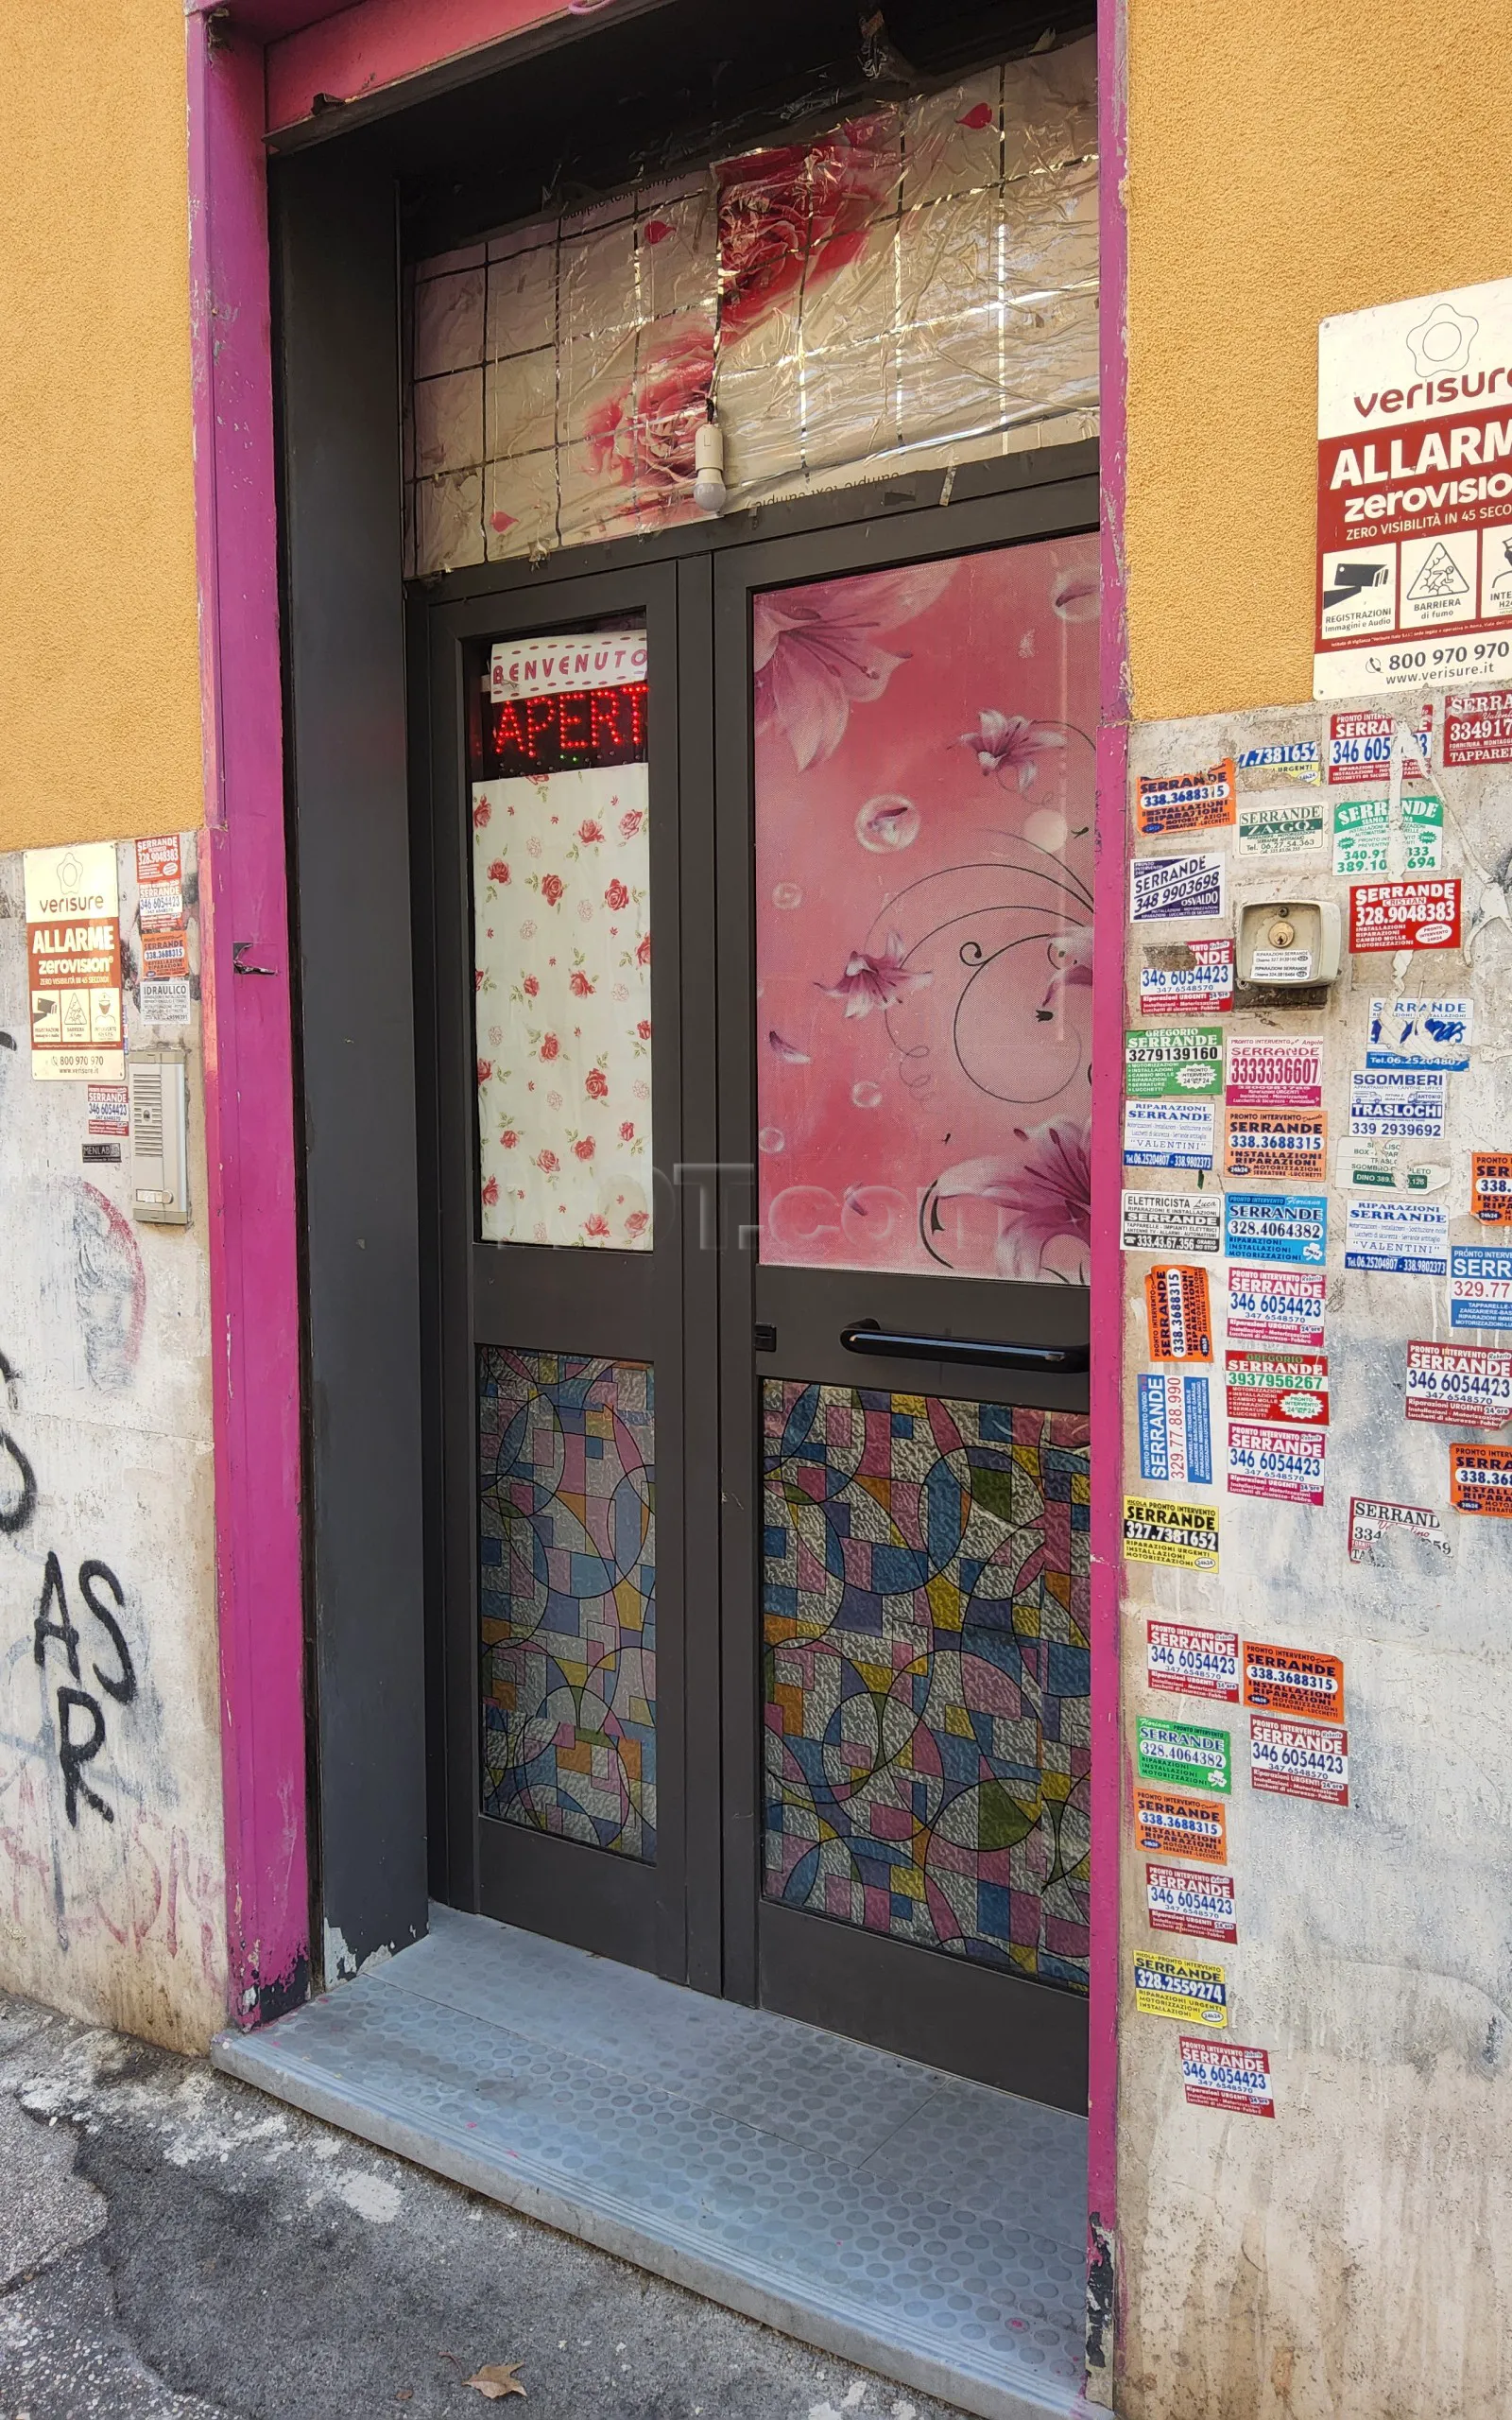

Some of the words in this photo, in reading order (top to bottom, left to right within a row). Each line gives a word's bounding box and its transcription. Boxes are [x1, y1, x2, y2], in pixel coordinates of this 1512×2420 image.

[1353, 367, 1512, 419] verisur
[1346, 526, 1377, 541] ZERO
[1381, 513, 1441, 535] VISIBILITÀ
[1445, 513, 1457, 525] IN
[1462, 507, 1475, 521] 45
[1326, 608, 1391, 624] REGISTRAZIONI
[1414, 598, 1461, 612] BARRIERA
[1420, 611, 1431, 620] di
[1434, 609, 1453, 617] fumo
[1325, 620, 1360, 632] Immagini
[1368, 617, 1391, 628] Audio
[492, 648, 647, 685] BENVENUTO
[1388, 651, 1426, 671] 800
[1433, 646, 1468, 666] 970
[1474, 641, 1510, 661] 970
[1386, 662, 1494, 684] www.verisure.it
[1333, 739, 1359, 764] 346
[1241, 806, 1320, 824] SERRANDE
[1338, 800, 1439, 825] SERRNDE
[137, 837, 178, 851] SERRANDE
[1136, 856, 1206, 893] SERRANDE
[140, 886, 180, 898] SERRANDE
[1134, 892, 1159, 913] 348
[1162, 872, 1219, 904] 9903698
[1181, 891, 1218, 906] OSVALDO
[1356, 883, 1454, 906] SERRANDE
[40, 895, 104, 913] verisure
[1356, 900, 1454, 926] 328.9048383
[32, 925, 114, 954] ALLARME
[1143, 969, 1166, 987] 346
[1171, 965, 1228, 985] 6054423
[144, 985, 186, 994] IDRAULICO
[1127, 1035, 1217, 1047] SERRANDE
[1145, 1028, 1198, 1037] GREGORIO
[60, 1056, 74, 1065] 800
[76, 1056, 88, 1065] 970
[1129, 1046, 1217, 1062] 3279139160
[1230, 1047, 1319, 1056] SERRANDE
[1231, 1058, 1318, 1083] 3333336607
[1353, 1074, 1442, 1085] SGOMBERI
[89, 1092, 127, 1103] SERRANDE
[1136, 1103, 1206, 1112] RIPARAZIONI
[1128, 1110, 1211, 1121] SERRANDE
[1353, 1105, 1442, 1117] TRASLOCHI
[1230, 1122, 1322, 1133] SERRANDE
[1352, 1123, 1376, 1134] 339
[1382, 1123, 1440, 1136] 2939692
[1231, 1135, 1320, 1150] 338.3688315
[1128, 1196, 1190, 1208] ELETTRICISTA
[1229, 1205, 1323, 1220] SERRANDE
[1359, 1202, 1439, 1212] RIPARAZIONI
[1127, 1213, 1217, 1225] SERRANDE
[1350, 1209, 1446, 1223] SERRANDE
[1230, 1220, 1320, 1238] 328.4064382
[1137, 1236, 1194, 1250] 333.43.67.356
[1229, 1244, 1291, 1253] INSTALLAZIONI
[1228, 1252, 1301, 1260] MOTORIZZAZIONI
[1231, 1278, 1322, 1297] SERRANDE
[1260, 1273, 1299, 1282] INTERVENTO
[1157, 1271, 1171, 1357] SERRANDE
[1169, 1274, 1184, 1353] 338.3688315
[1230, 1292, 1255, 1311] 346
[1261, 1295, 1321, 1317] 6054423
[1228, 1360, 1322, 1375] SERRANDE
[1410, 1354, 1510, 1376] SERRANDE
[1228, 1373, 1322, 1390] 3937956267
[1409, 1370, 1436, 1390] 346
[1441, 1374, 1510, 1398] 6054423
[1448, 1394, 1492, 1405] 6548570
[1148, 1378, 1166, 1478] SERRANDE
[1167, 1377, 1184, 1479] 329.77.88.990
[1231, 1434, 1321, 1457] SERRANDE
[1230, 1448, 1254, 1467] 346
[1260, 1453, 1320, 1477] 6054423
[1127, 1506, 1214, 1530] SERRANDE
[1126, 1521, 1215, 1550] 327.7381652
[1151, 1632, 1235, 1656] SERRANDE
[1152, 1646, 1174, 1665] 346
[1179, 1650, 1235, 1675] 6054423
[1247, 1653, 1335, 1677] SERRANDE
[1251, 1667, 1332, 1690] 338.3688315
[1248, 1680, 1335, 1700] INSTALLAZIONI
[1141, 1727, 1224, 1751] SERRANDE
[1253, 1727, 1342, 1754] SERRANDE
[1143, 1742, 1222, 1768] 328.4064382
[1253, 1742, 1278, 1762] 346
[1282, 1748, 1343, 1774] 6054423
[1139, 1800, 1220, 1822] SERRANDE
[1143, 1812, 1217, 1835] 338.3688315
[1150, 1874, 1230, 1897] SERRANDE
[1151, 1887, 1173, 1904] 346
[1178, 1892, 1232, 1914] 6054423
[1136, 1958, 1221, 1982] SERRANDE
[1138, 1969, 1222, 2003] 328.2559274
[1183, 2048, 1264, 2072] SERRANDE
[1183, 2062, 1206, 2079] 346
[1211, 2066, 1265, 2089] 6054423
